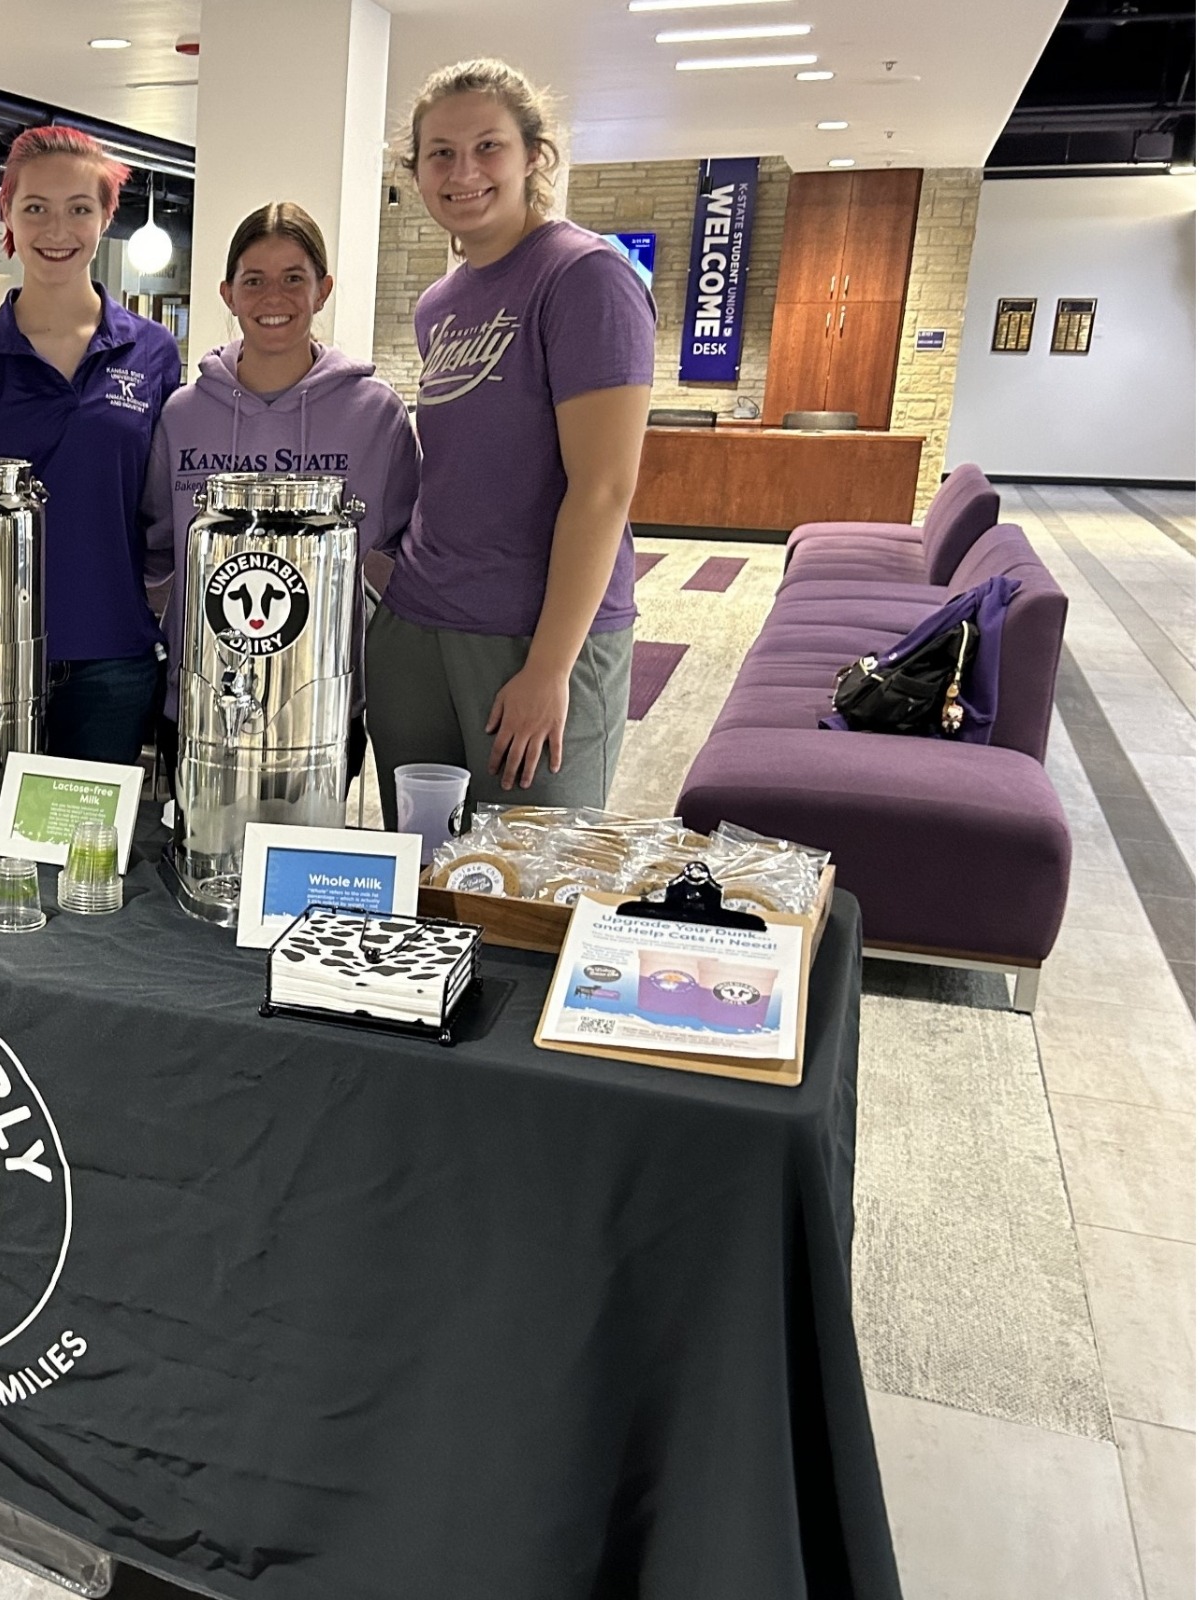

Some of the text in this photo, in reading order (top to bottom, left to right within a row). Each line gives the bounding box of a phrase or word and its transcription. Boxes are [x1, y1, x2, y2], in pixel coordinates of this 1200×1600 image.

[694, 184, 735, 337] WELCOME
[724, 183, 748, 324] K-STATE STUDENT UNION
[693, 343, 727, 355] DESK
[175, 481, 205, 492] Bakery
[209, 555, 305, 595] UNDENIABLY
[52, 781, 114, 797] Lactose-free
[79, 794, 100, 805] Milk
[309, 873, 382, 890] Whole Milk
[602, 914, 670, 930] Upgrade
[675, 923, 712, 934] Your
[592, 922, 777, 950] and Help Cats in Need!
